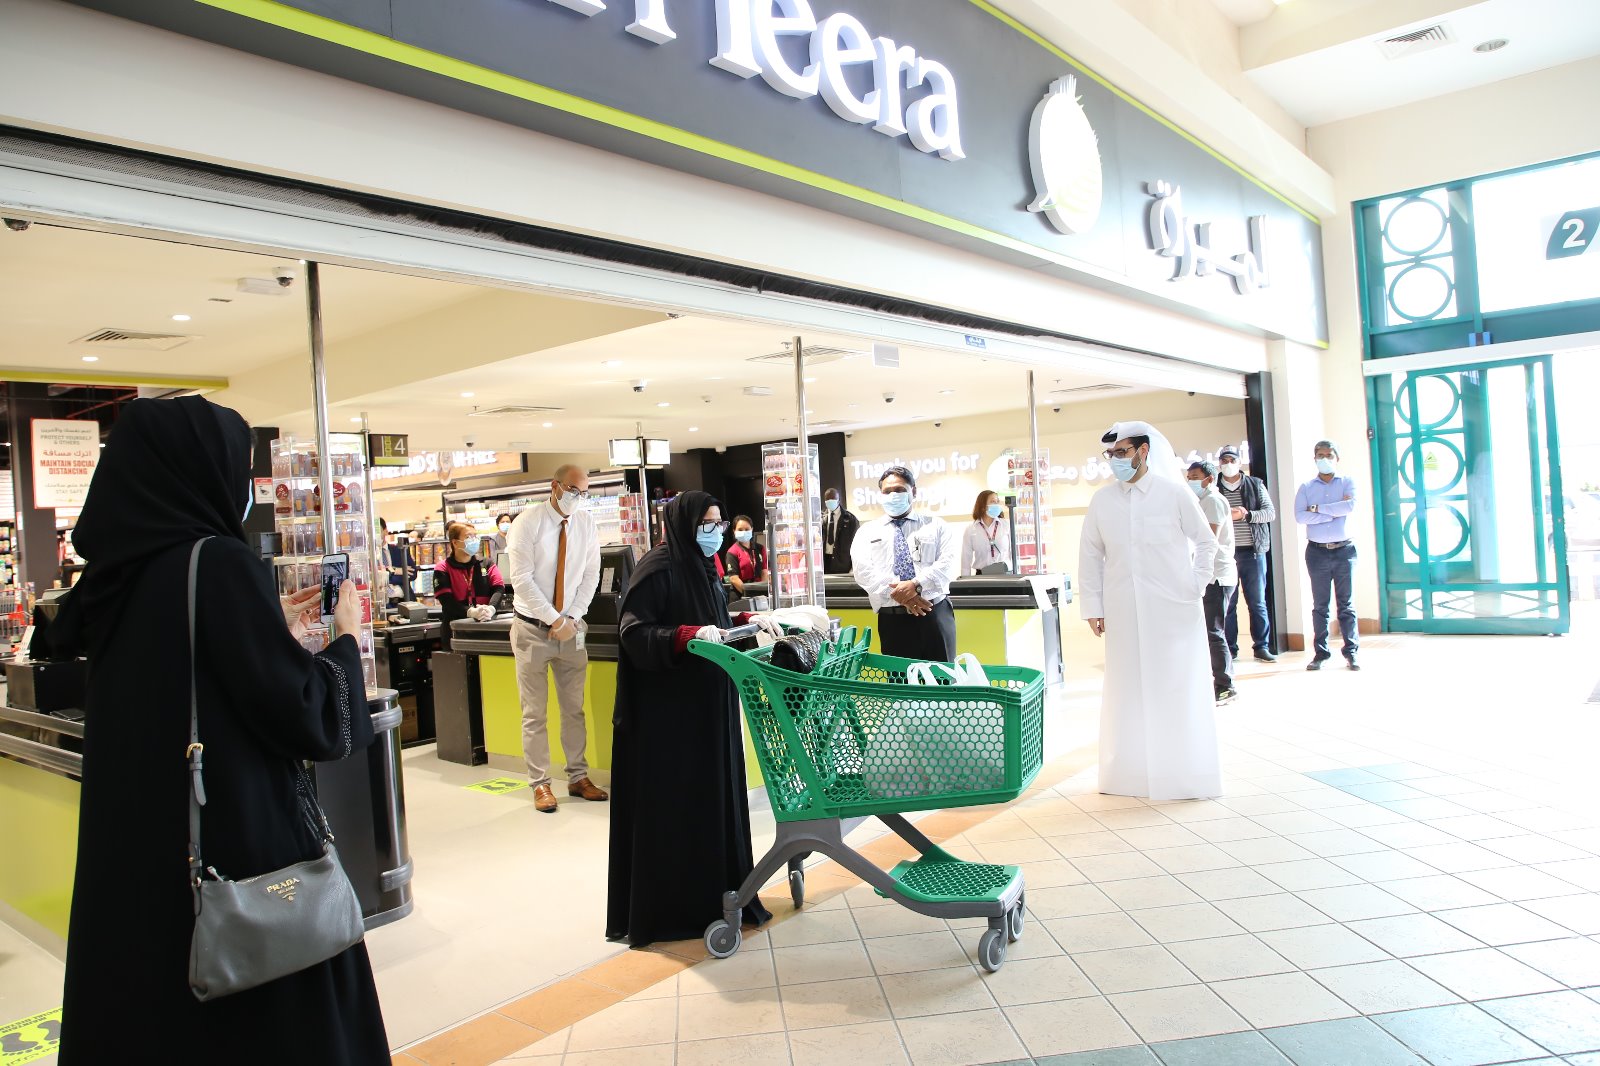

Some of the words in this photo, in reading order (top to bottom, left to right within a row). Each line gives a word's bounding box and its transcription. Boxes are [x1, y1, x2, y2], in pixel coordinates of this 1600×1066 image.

[1562, 218, 1586, 249] 2
[394, 437, 406, 455] 4
[49, 467, 88, 475] DISTANCING
[910, 457, 946, 479] you
[950, 451, 979, 473] for
[266, 877, 300, 893] PRADA
